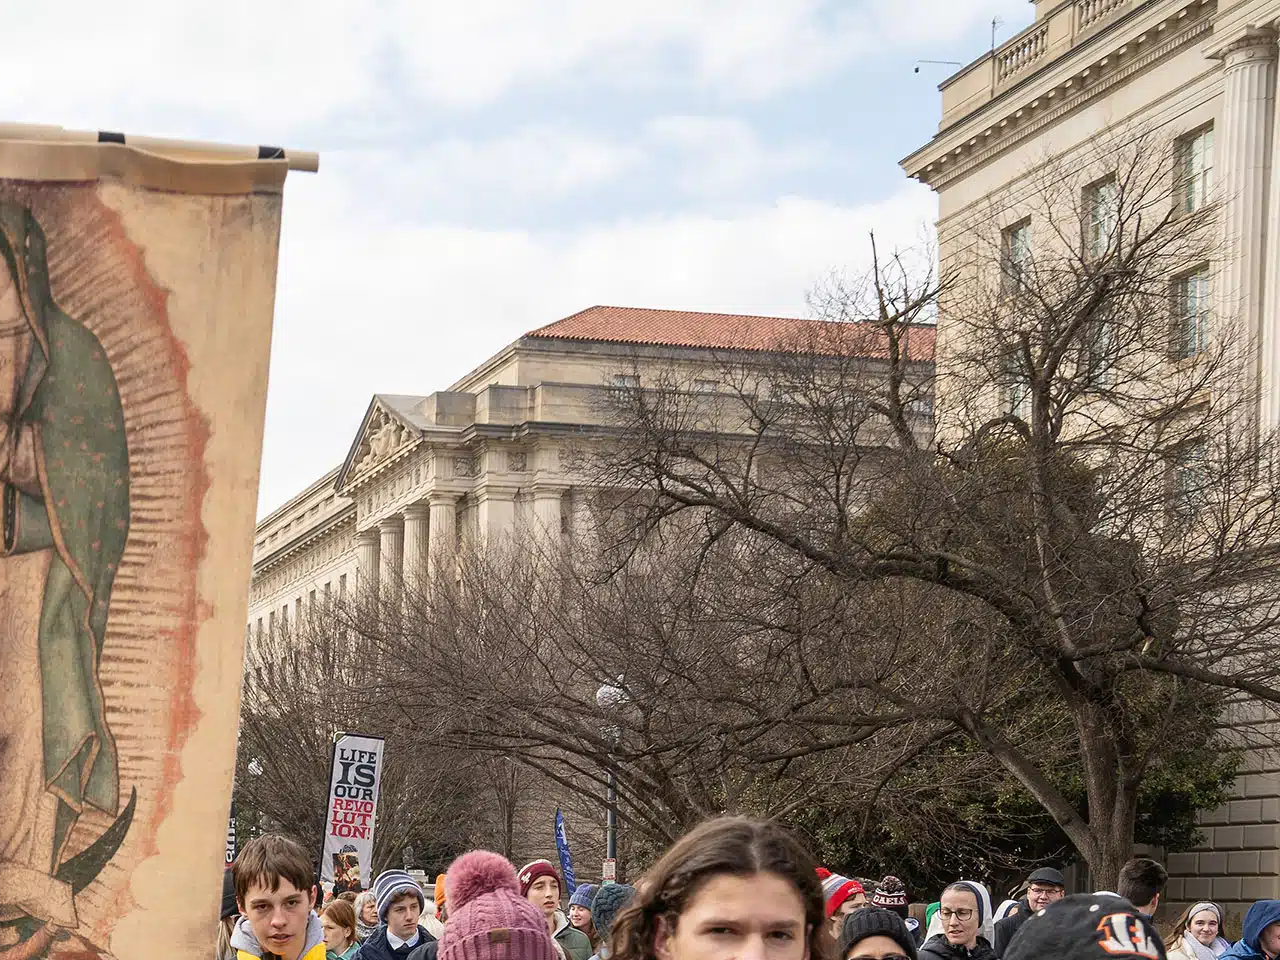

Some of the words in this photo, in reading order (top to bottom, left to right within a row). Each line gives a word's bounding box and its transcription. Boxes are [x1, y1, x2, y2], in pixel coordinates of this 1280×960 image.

[340, 748, 377, 764] LIFE
[336, 761, 376, 787] IS
[334, 785, 373, 801] OUR
[333, 798, 374, 814] REVO
[332, 810, 372, 827] LUT
[330, 823, 371, 840] ION!
[873, 894, 905, 905] GAELS
